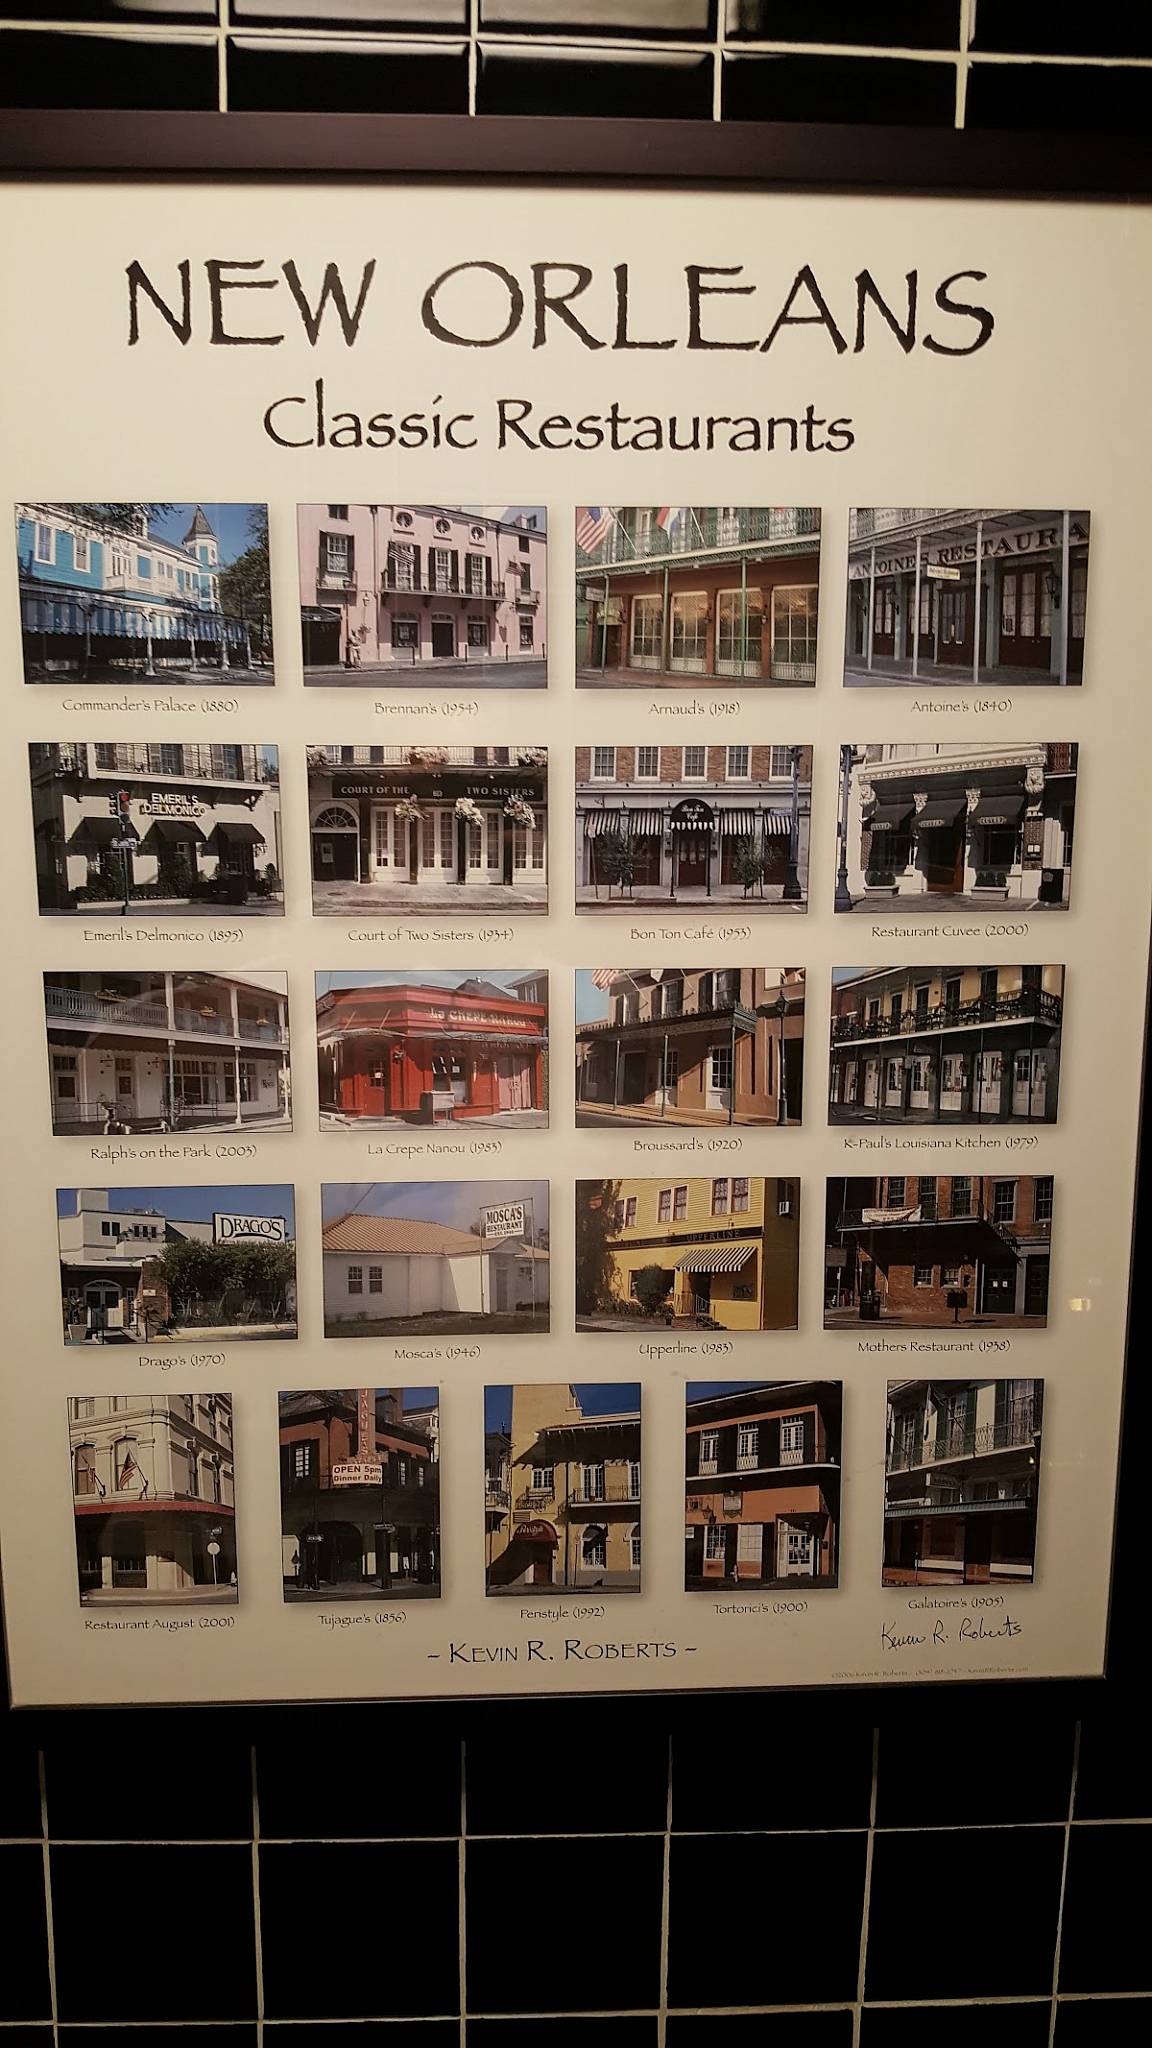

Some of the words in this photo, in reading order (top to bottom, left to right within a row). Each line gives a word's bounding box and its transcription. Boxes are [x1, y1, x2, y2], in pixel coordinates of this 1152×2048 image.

[124, 258, 377, 347] NEW
[421, 260, 995, 357] ORLEANS
[263, 377, 478, 450] Classic
[496, 399, 855, 453] Restaurants
[62, 695, 151, 712] Commander's
[153, 696, 196, 712] Palace
[200, 698, 239, 713] (1880)
[374, 702, 438, 715] Brennan's
[441, 701, 479, 716] (1954)
[650, 699, 705, 715] Arnaud's
[709, 701, 741, 716] (1918)
[912, 700, 970, 713] Antoine's
[973, 698, 1013, 714] (1840)
[151, 792, 199, 804] EMERIL'S
[340, 786, 374, 794] COURT
[376, 786, 391, 794] OF
[466, 786, 489, 795] TWO
[491, 787, 535, 796] SISTERS
[142, 802, 206, 817] DELMONICO
[83, 926, 133, 941] Emeril's
[136, 926, 205, 942] Delmonico
[208, 928, 244, 943] (1895)
[347, 930, 386, 941] Court
[388, 926, 403, 941] of
[404, 929, 430, 941] Two
[431, 929, 474, 941] Sisters
[478, 927, 514, 943] (1934)
[630, 928, 656, 940] Bon
[658, 928, 681, 940] Ton
[683, 924, 714, 939] Café
[718, 926, 752, 941] (1953)
[871, 926, 938, 937] Restaurant
[942, 925, 981, 937] Cuvee
[985, 923, 1029, 937] (2000)
[633, 1136, 704, 1151] Broussard's
[707, 1137, 743, 1152] (1920)
[844, 1135, 893, 1149] K-Paul's
[895, 1137, 952, 1149] Louisiana
[955, 1133, 1001, 1148] Kitchen
[1005, 1135, 1039, 1149] (1979)
[90, 1144, 137, 1165] Ralph's
[139, 1150, 156, 1159] on
[158, 1143, 180, 1158] the
[183, 1143, 212, 1158] Park
[215, 1144, 257, 1158] (2003)
[367, 1143, 383, 1155] La
[385, 1143, 424, 1160] Crepe
[426, 1143, 466, 1154] Nanou
[469, 1140, 502, 1155] (1983)
[486, 1206, 523, 1224] MOSCA'S
[220, 1217, 282, 1240] DRAGO'S
[394, 1348, 442, 1359] Mosca's
[445, 1345, 481, 1360] (1946)
[639, 1340, 697, 1360] Upperline
[701, 1341, 734, 1355] (1983)
[858, 1338, 907, 1352] Mothers
[910, 1341, 974, 1352] Restaurant
[978, 1339, 1011, 1353] (1938)
[138, 1356, 187, 1371] Drago's
[190, 1352, 226, 1367] (1970)
[333, 1465, 361, 1474] OPEN
[712, 1603, 769, 1614] Tortorici's
[772, 1601, 808, 1615] (1900)
[908, 1596, 968, 1609] Galatoire's
[970, 1595, 1004, 1609] (1905)
[317, 1613, 371, 1630] Tujague's
[374, 1611, 407, 1625] (1856)
[520, 1604, 569, 1623] Peristyle
[572, 1605, 605, 1619] (1992)
[84, 1619, 150, 1630] Restaurant
[153, 1618, 195, 1633] August
[198, 1616, 235, 1629] (2001)
[932, 1619, 949, 1645] R.
[449, 1642, 518, 1664] KEVIN
[527, 1640, 554, 1662] R.
[564, 1639, 677, 1661] ROBERTS
